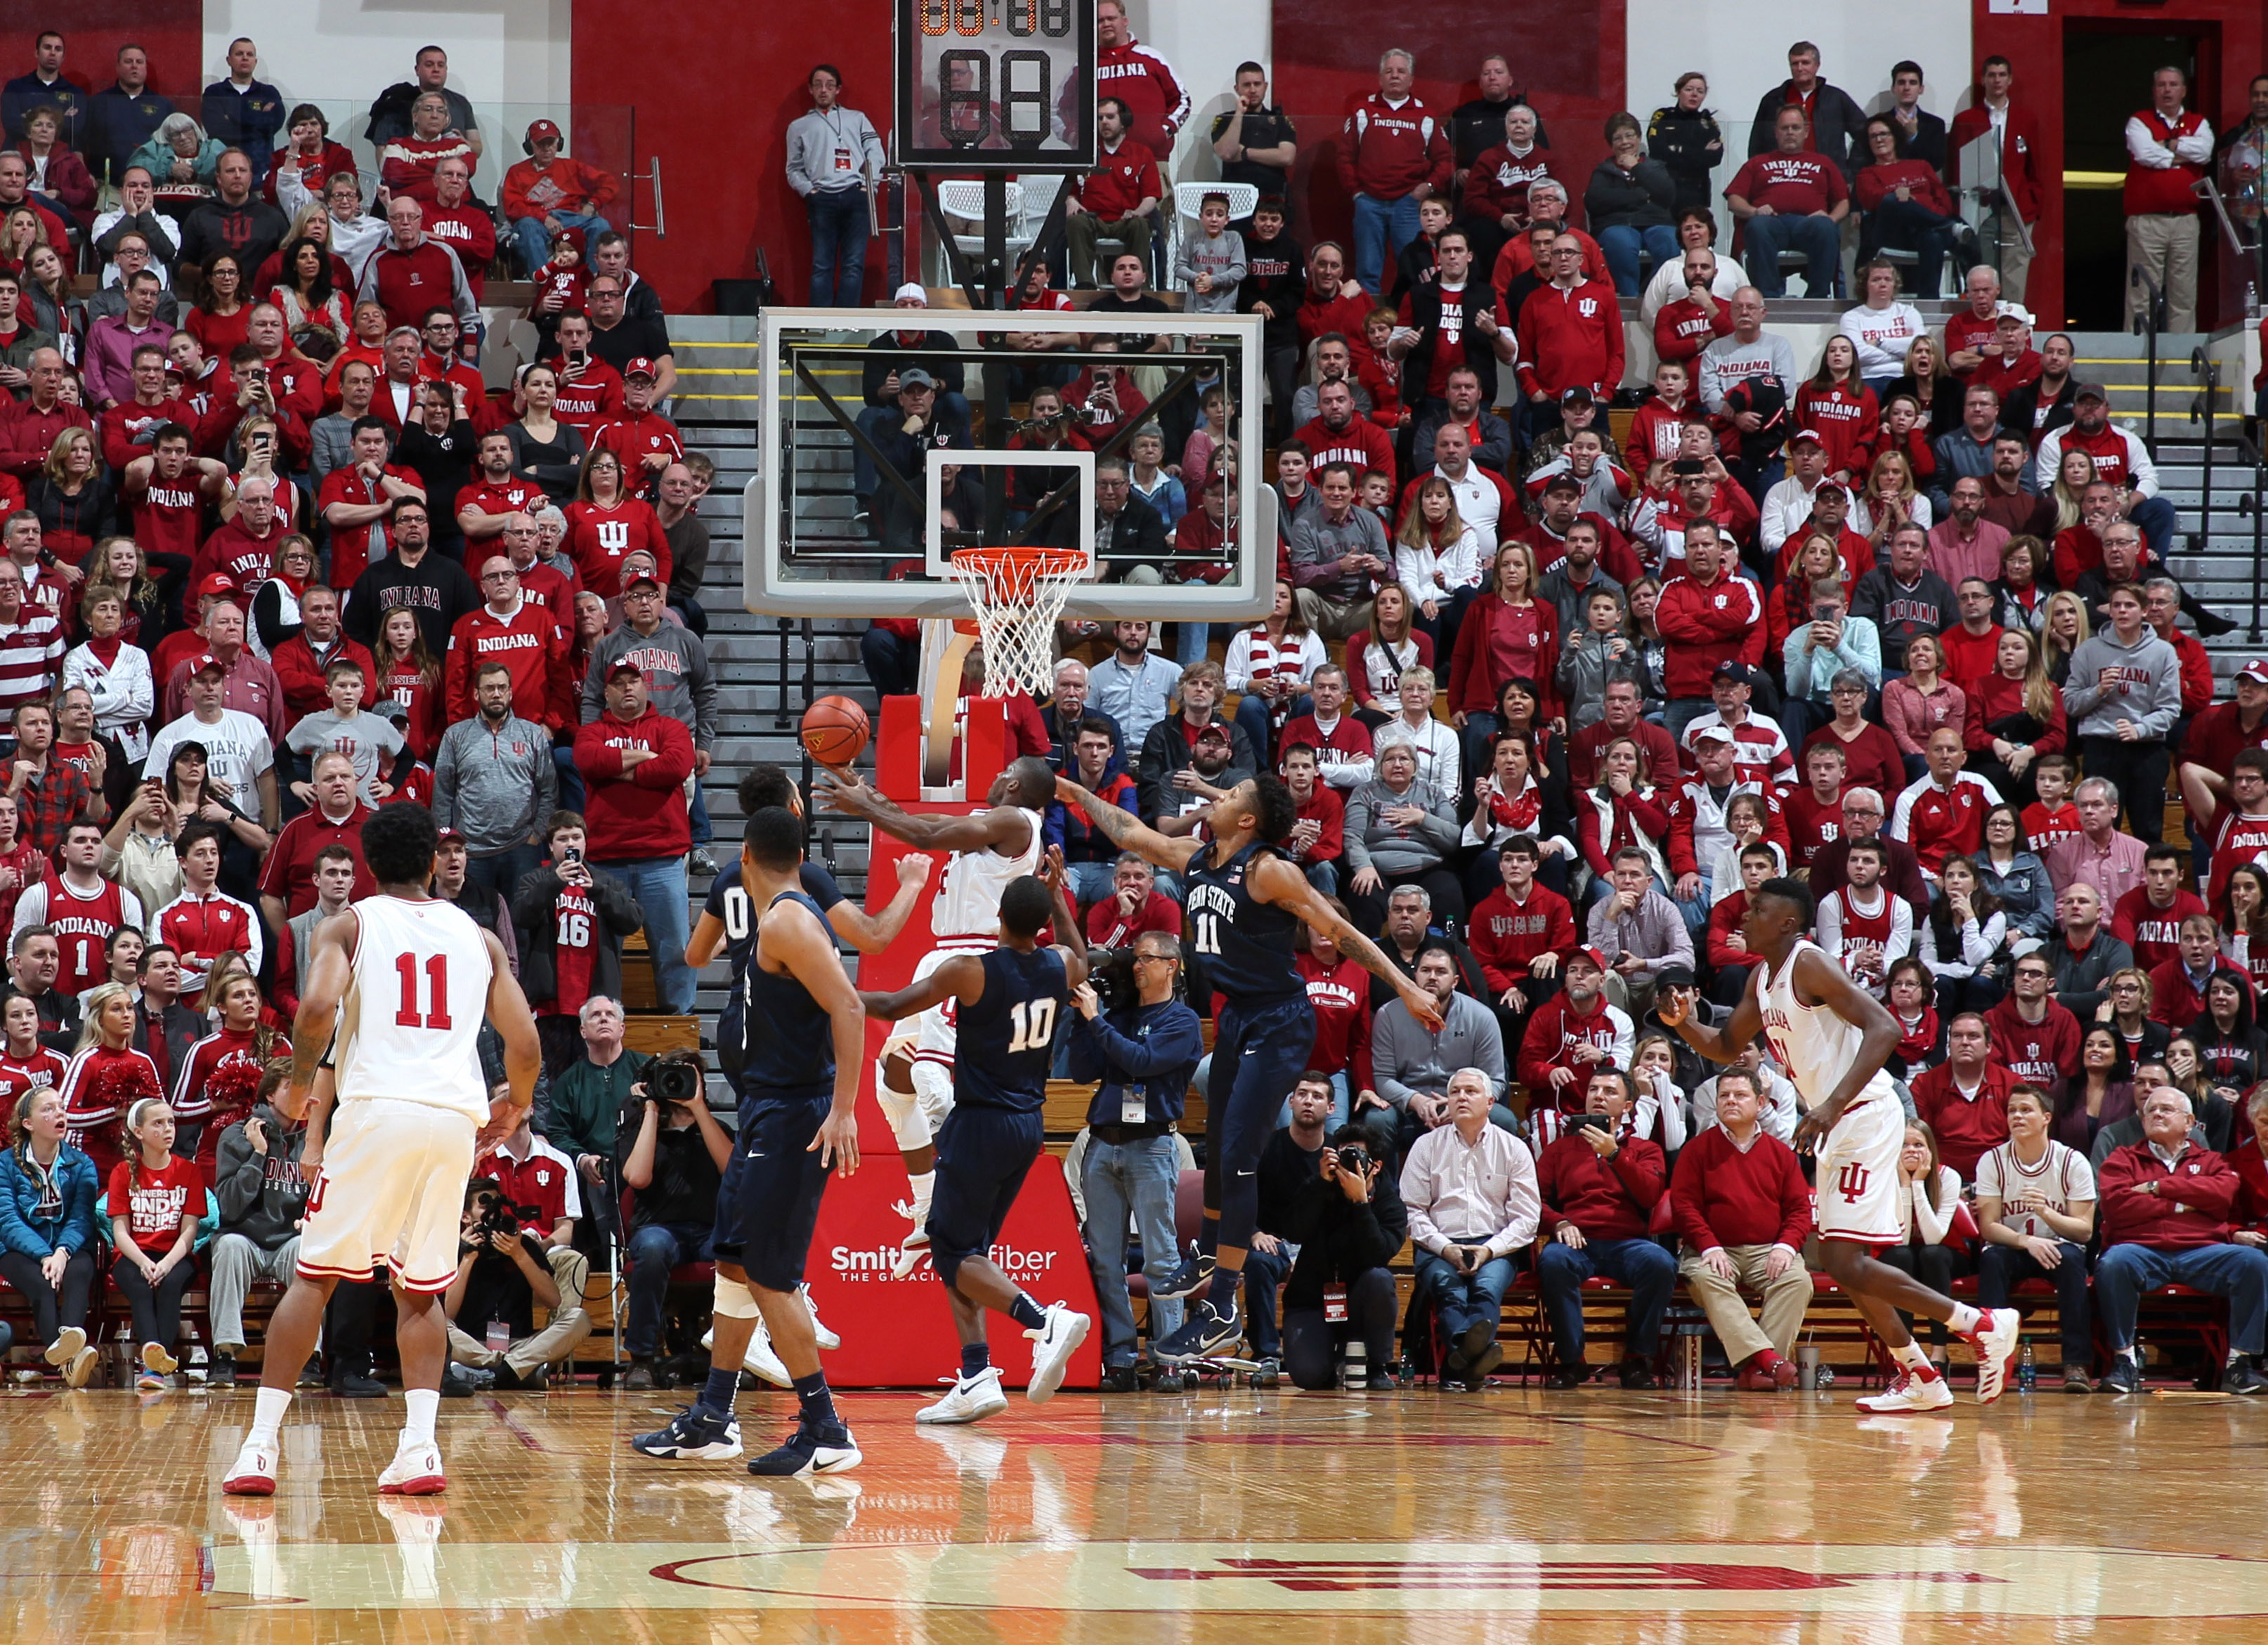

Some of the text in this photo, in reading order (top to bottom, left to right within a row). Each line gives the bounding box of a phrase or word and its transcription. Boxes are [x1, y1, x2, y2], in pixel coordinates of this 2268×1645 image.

[1097, 63, 1147, 80] DIANA
[1375, 119, 1416, 131] INDIANA
[1762, 160, 1821, 173] INDIANA
[1578, 298, 1597, 317] IU
[1676, 320, 1711, 336] INDIA
[554, 399, 596, 413] NDIANA
[1810, 401, 1861, 418] INDIANA
[597, 520, 628, 556] IU
[1714, 594, 1728, 610] IU
[477, 634, 539, 653] INDIANA
[204, 740, 247, 758] DIANA
[2231, 832, 2268, 850] INDIA
[723, 886, 748, 941] 0
[1187, 884, 1236, 924] PENN STATE
[556, 915, 590, 948] 16
[1194, 913, 1222, 955] 11
[75, 939, 89, 976] 1
[396, 951, 452, 1030] 11
[1305, 982, 1356, 1005] NDIANA
[1008, 997, 1057, 1054] 10
[2009, 1061, 2057, 1079] NDIANA
[536, 1170, 549, 1186] IU
[1839, 1162, 1870, 1204] IU
[987, 1244, 1056, 1270] fiber
[840, 1273, 871, 1283] THE
